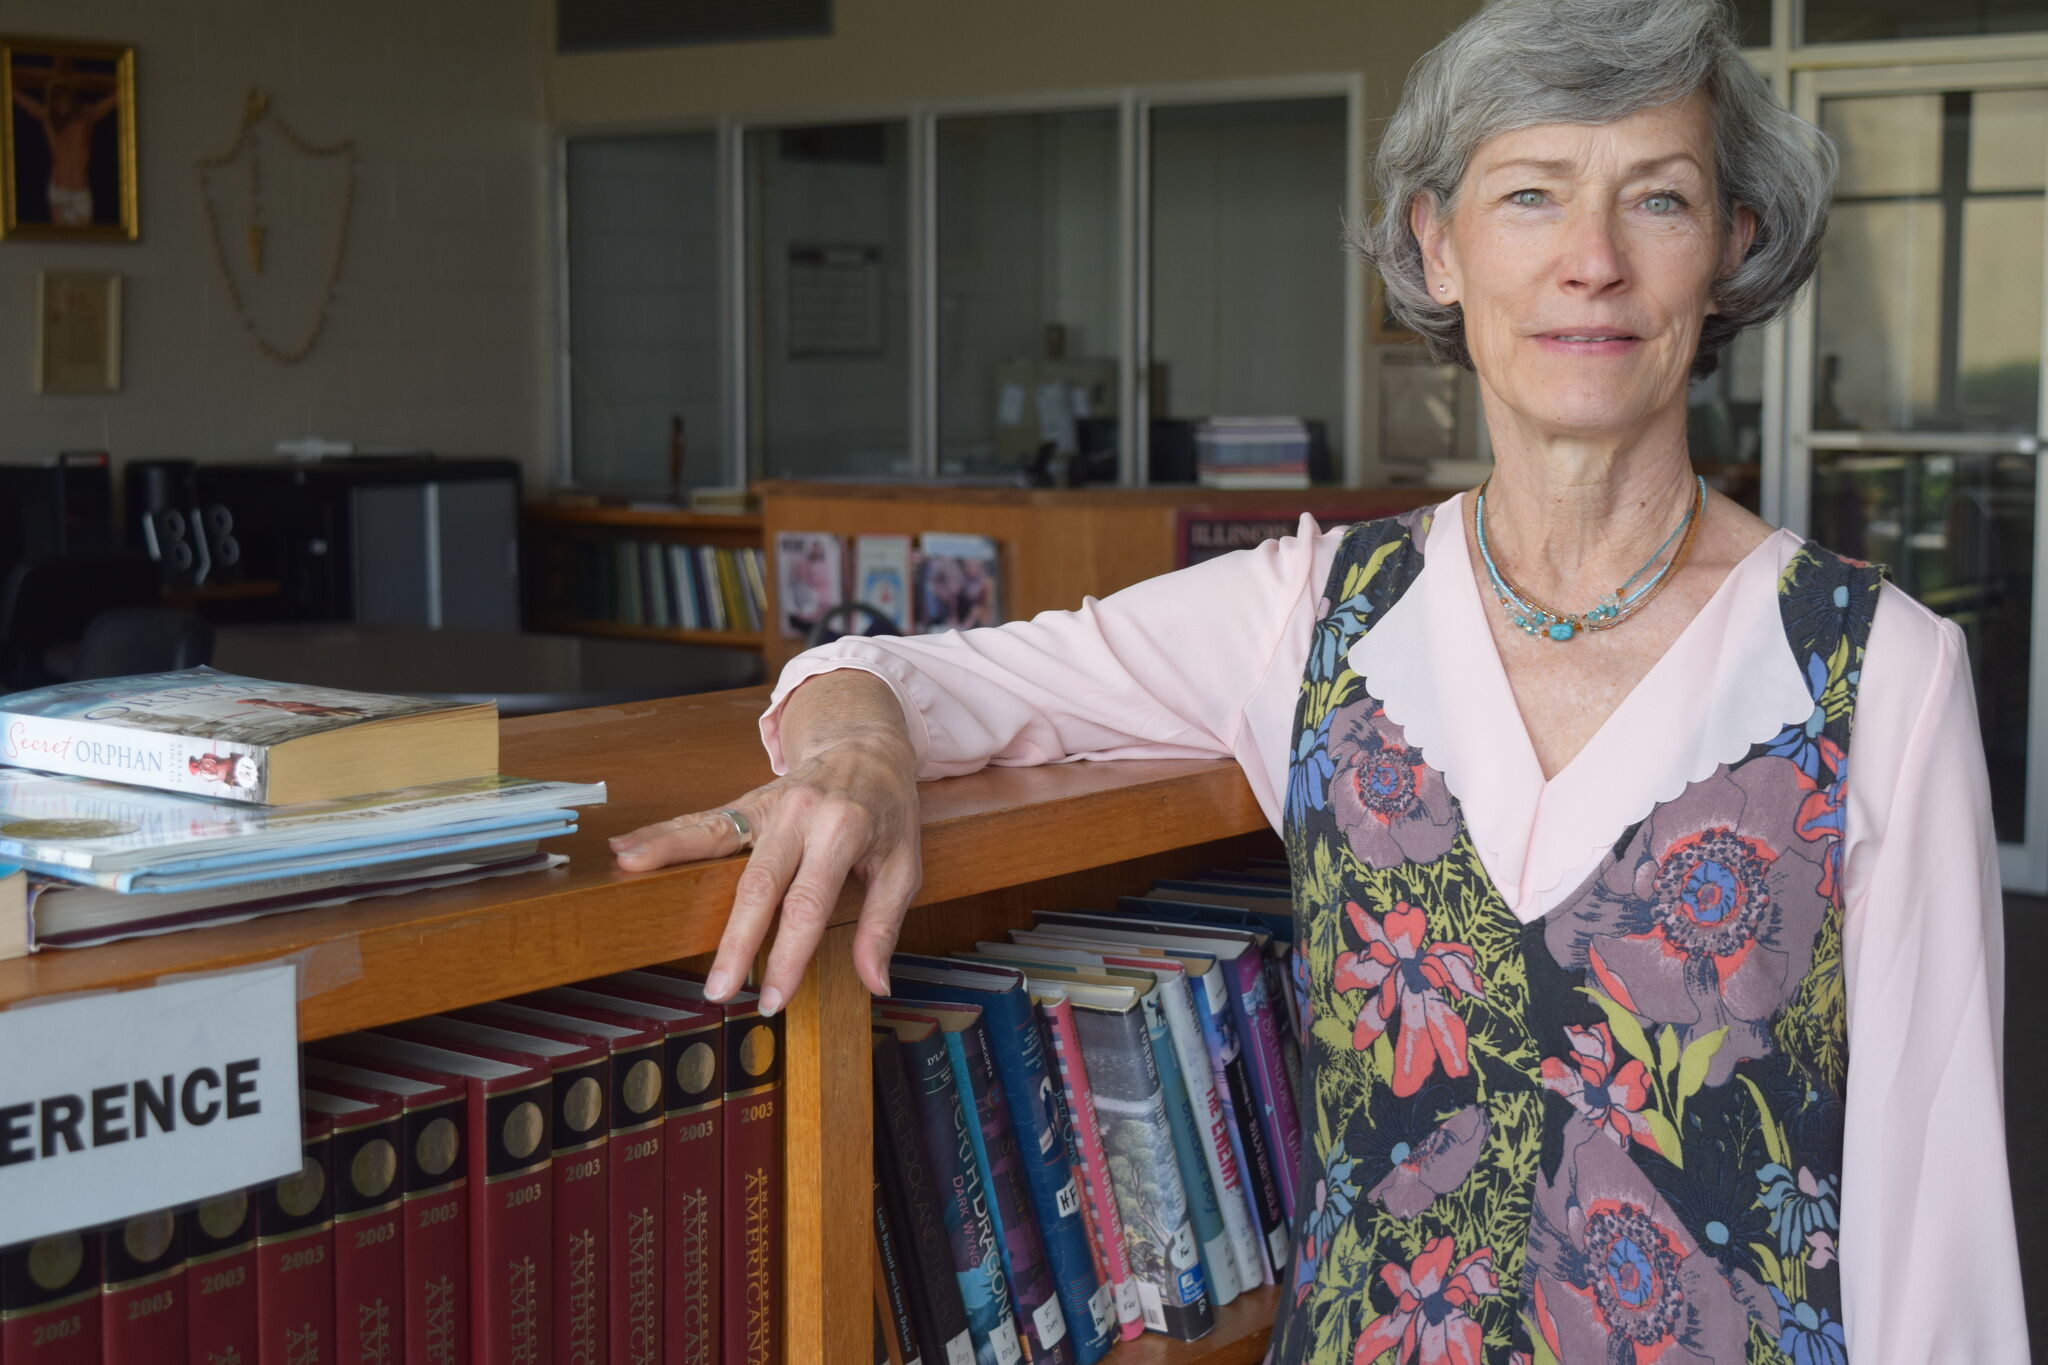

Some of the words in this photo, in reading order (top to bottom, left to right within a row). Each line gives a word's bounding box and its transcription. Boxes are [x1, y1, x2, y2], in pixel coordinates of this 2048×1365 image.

[4, 721, 72, 760] Secret
[76, 740, 162, 772] ORPHAN
[977, 1029, 993, 1079] DASGUPTA
[1139, 1024, 1156, 1080] FORBES
[0, 1058, 261, 1167] ERENCE
[741, 1102, 774, 1124] 2003
[1206, 1087, 1222, 1119] THE
[679, 1120, 714, 1143] 2003
[1182, 1101, 1207, 1175] Breaker
[624, 1142, 659, 1162] 2003
[1212, 1118, 1240, 1191] ENEMY
[565, 1158, 600, 1183] 2003
[506, 1183, 542, 1209] 2003
[1101, 1164, 1122, 1237] FOREVER
[420, 1201, 459, 1228] 2003
[953, 1175, 970, 1218] DARK
[962, 1221, 981, 1267] WYNG
[355, 1222, 396, 1249] 2003
[280, 1245, 325, 1273] 2003
[762, 1174, 770, 1363] ENCYCLOPEDIA
[202, 1266, 246, 1295] 2003
[876, 1206, 886, 1233] Leah
[894, 1286, 904, 1315] Laura
[899, 1315, 912, 1353] DeLuca
[128, 1290, 175, 1320] 2003
[425, 1279, 444, 1362] AME
[33, 1315, 81, 1347] 2003
